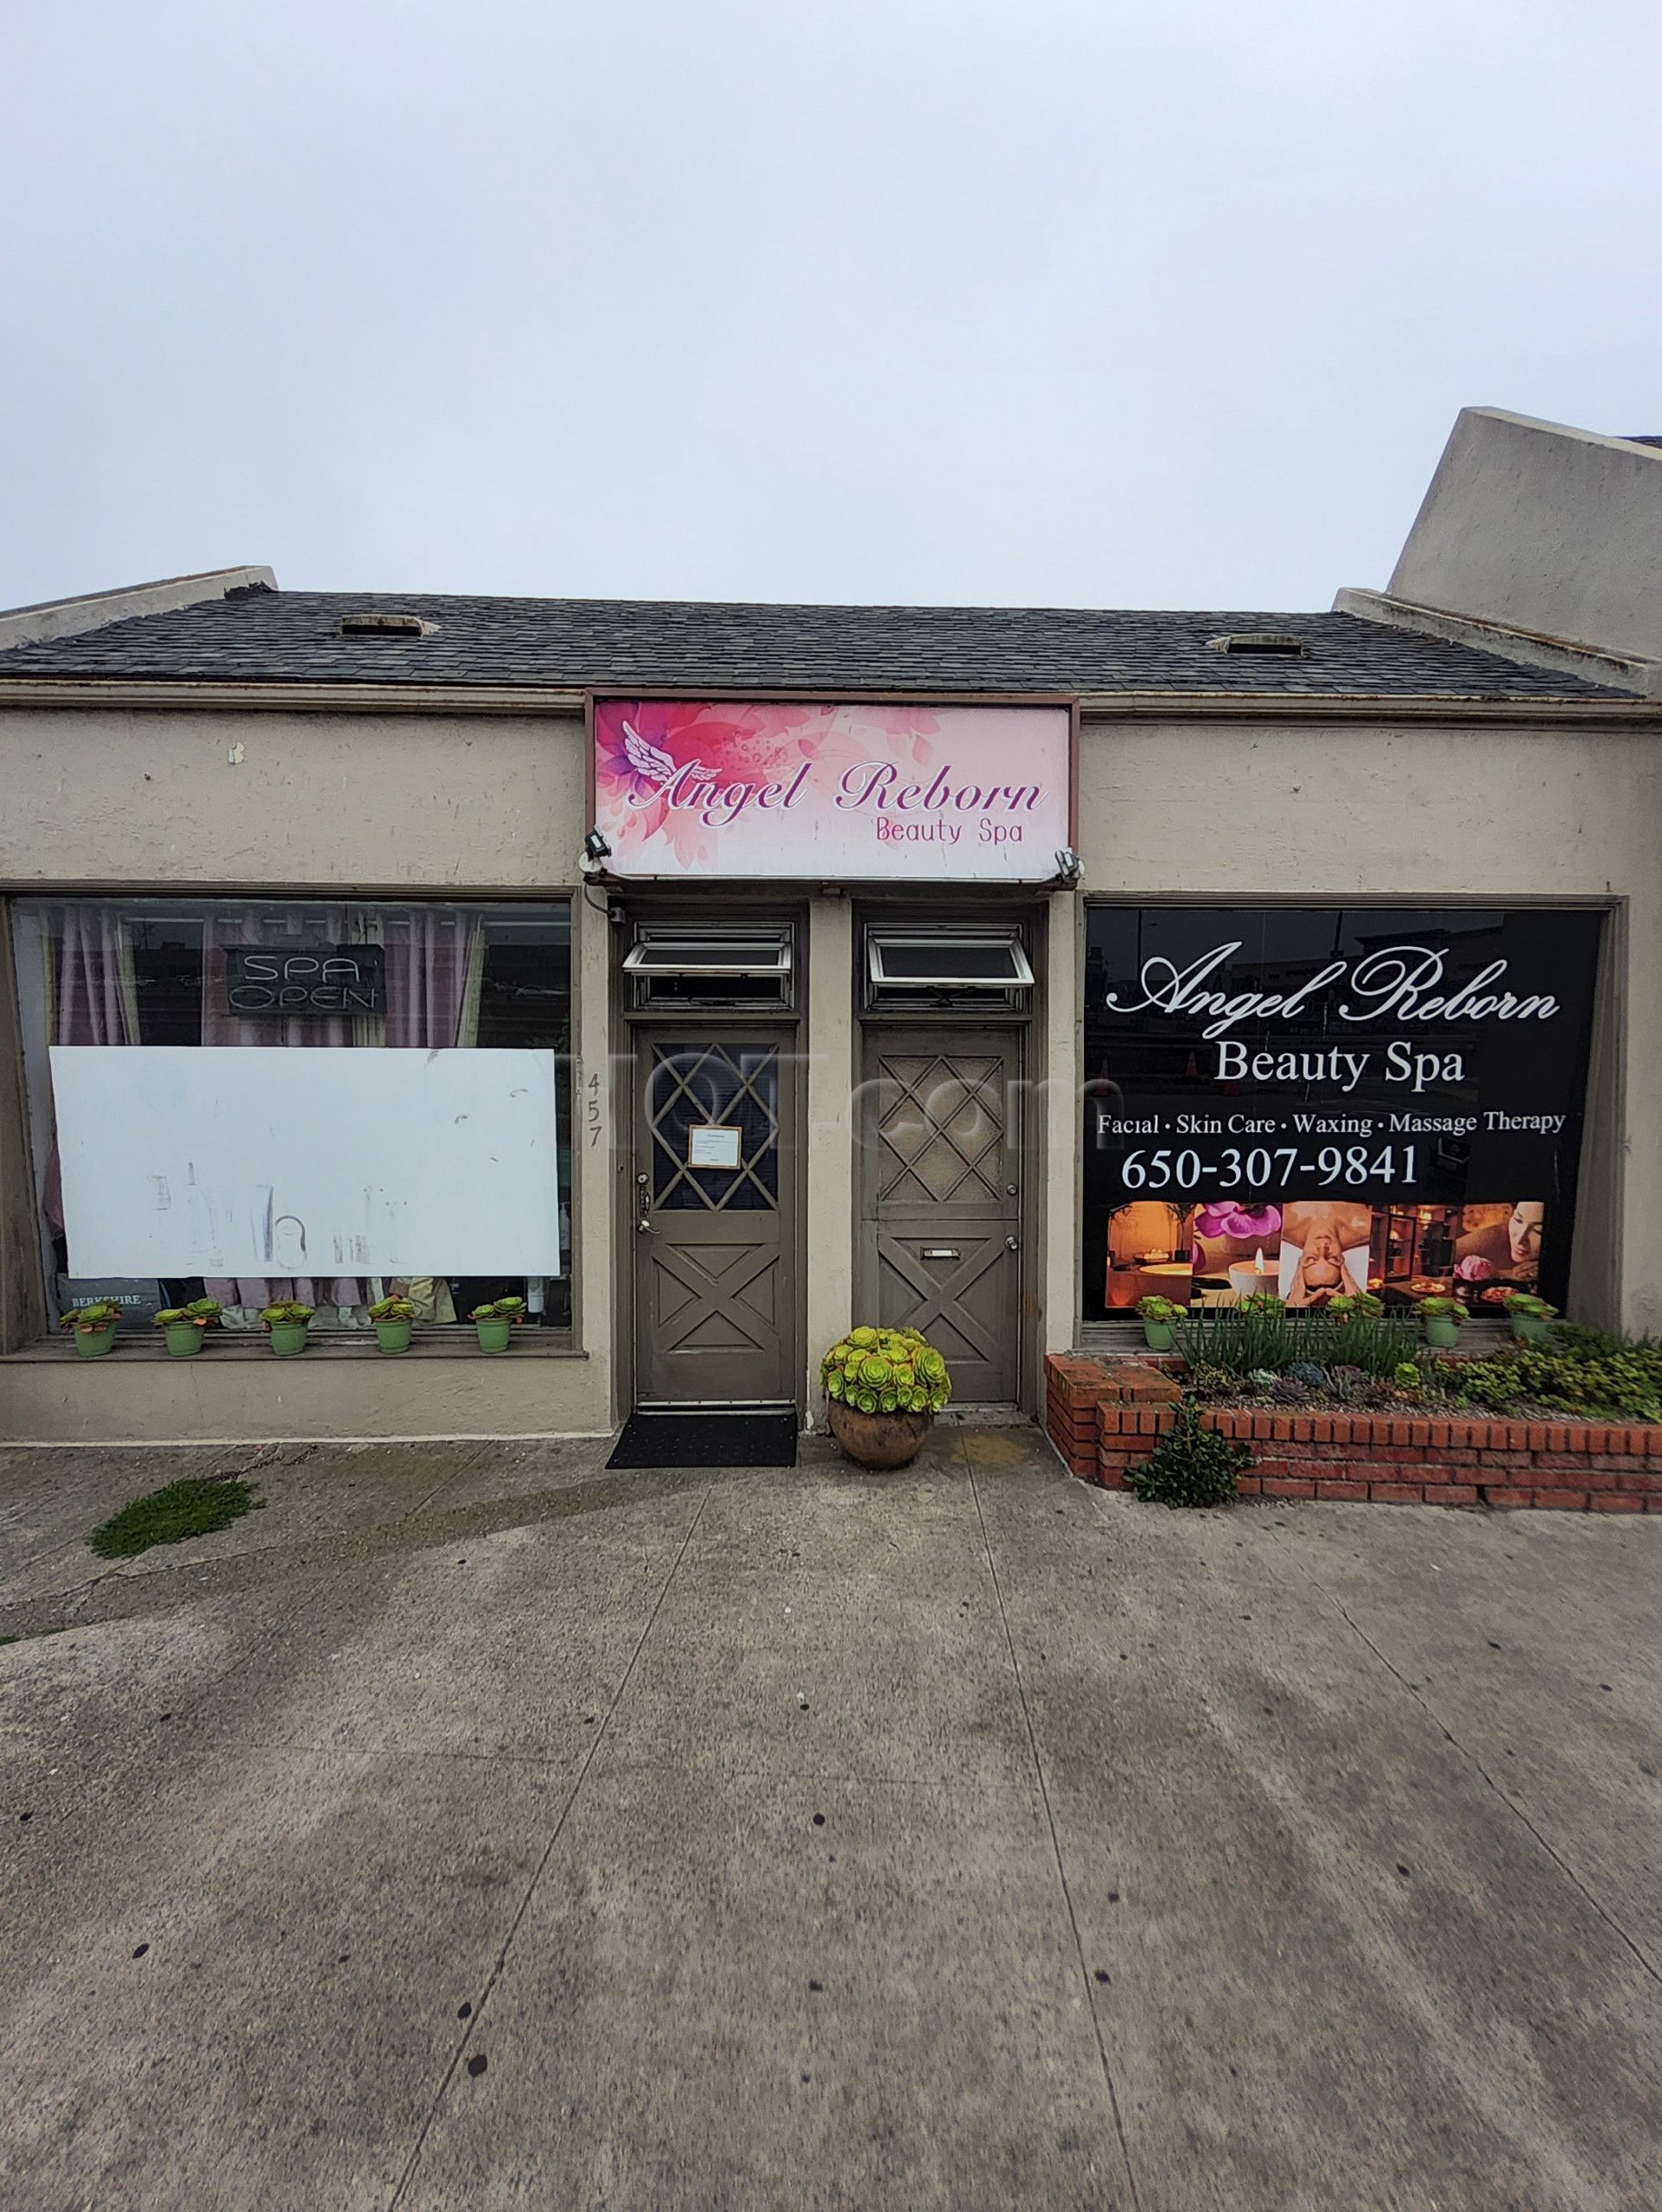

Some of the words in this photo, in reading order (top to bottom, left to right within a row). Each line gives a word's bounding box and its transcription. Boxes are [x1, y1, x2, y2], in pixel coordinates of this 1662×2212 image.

[628, 760, 812, 828] Angel
[835, 760, 1049, 812] Reborn
[876, 817, 962, 845] Beauty
[978, 817, 1023, 845] Spa
[244, 955, 360, 983] SPA
[1106, 941, 1347, 1039] Angel
[1339, 945, 1561, 1021] Reborn
[228, 984, 378, 1010] OPEN
[1213, 1040, 1371, 1092] Beauty
[1384, 1041, 1466, 1093] Spa
[587, 1072, 602, 1148] 457
[1097, 1114, 1159, 1135] Facial
[1175, 1113, 1222, 1135] Skin
[1227, 1114, 1277, 1134] Care
[1292, 1113, 1373, 1137] Waxing
[1388, 1113, 1477, 1136] Massage
[1483, 1110, 1566, 1135] Therapy
[1122, 1145, 1417, 1189] 650-307-9841
